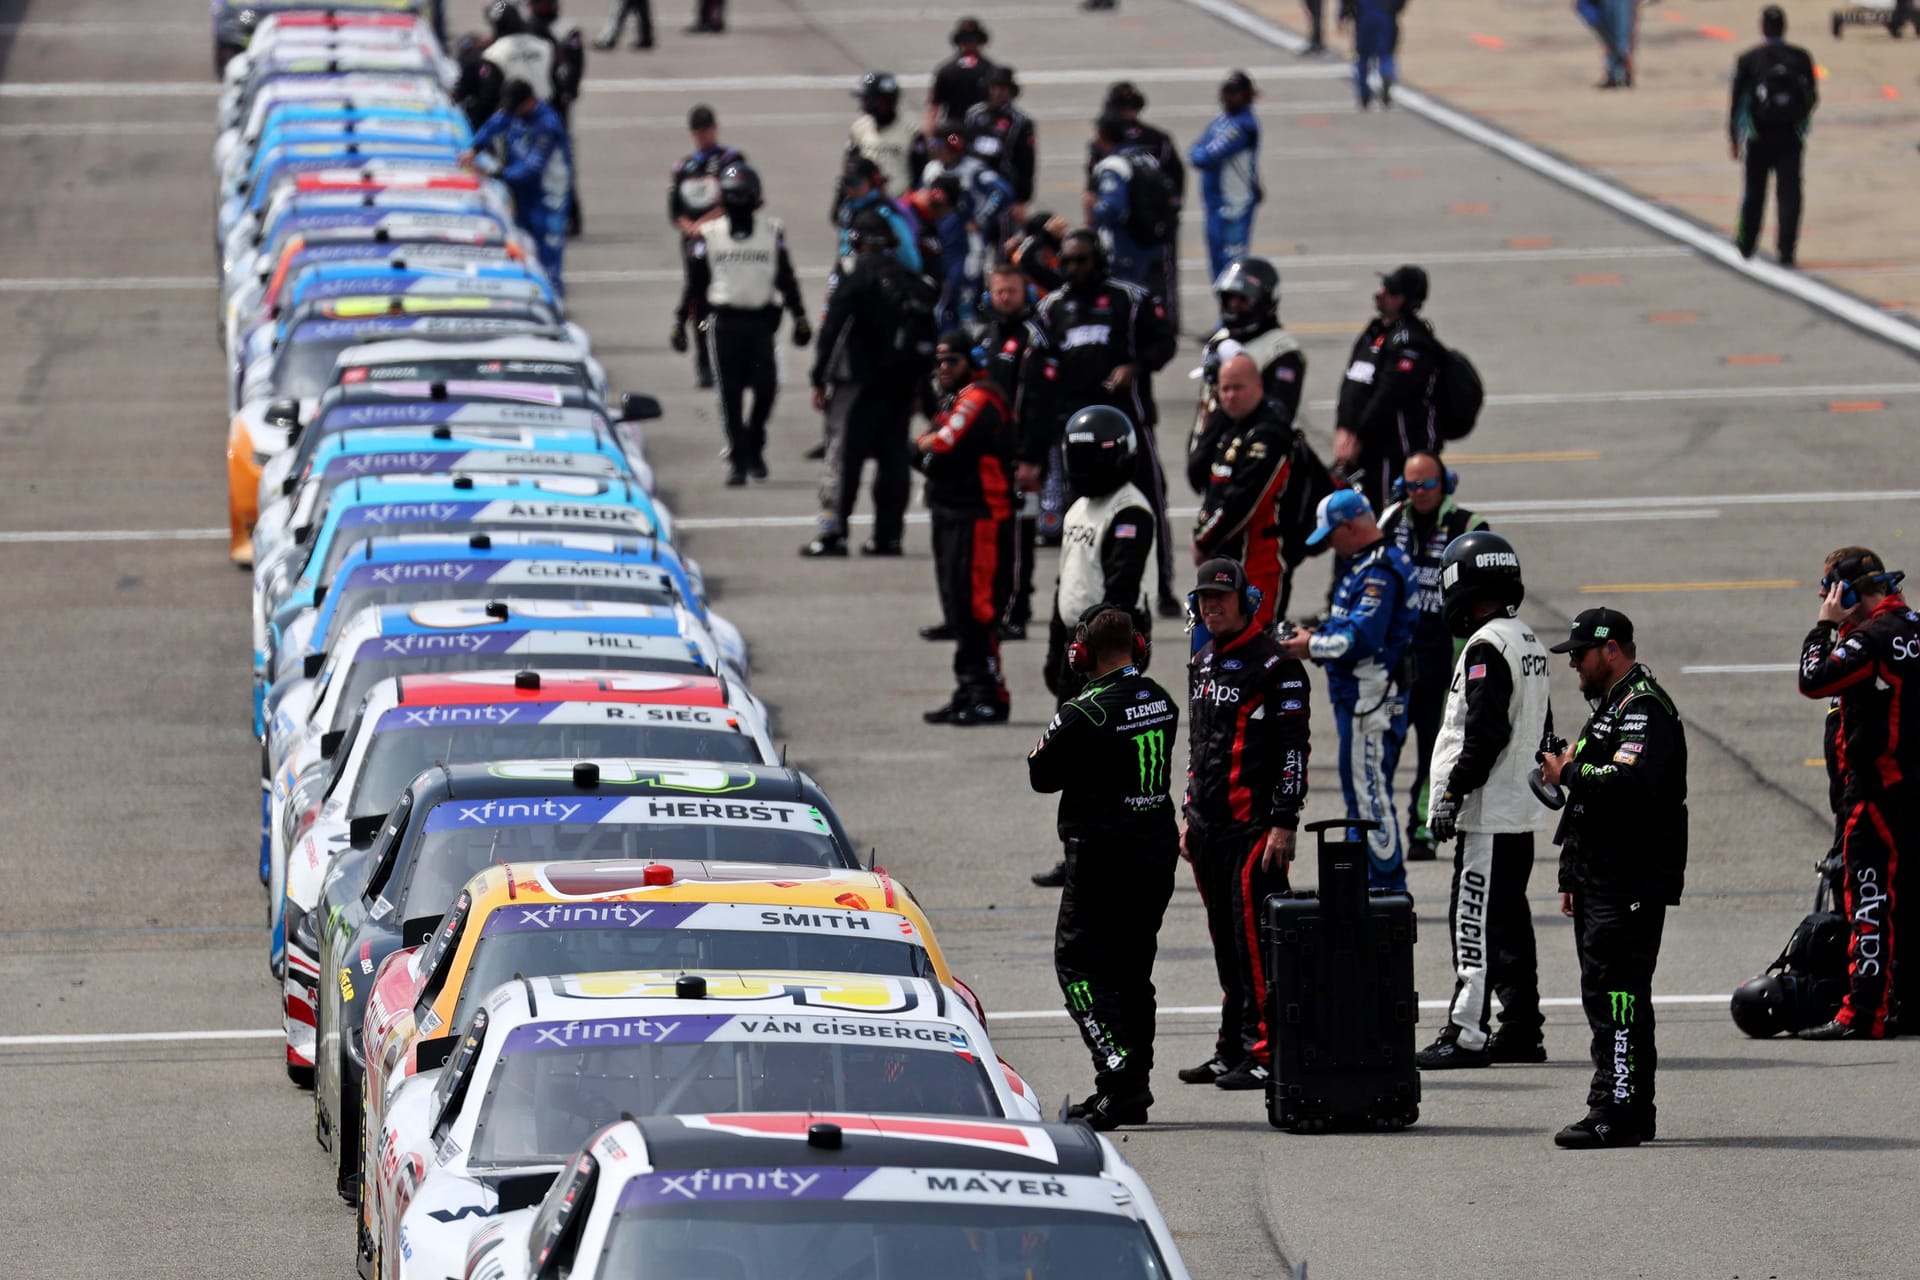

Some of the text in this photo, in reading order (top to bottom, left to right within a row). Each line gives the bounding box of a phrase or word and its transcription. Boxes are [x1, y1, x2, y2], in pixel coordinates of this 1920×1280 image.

[348, 452, 438, 471] xfinity
[505, 454, 576, 466] POOLE
[362, 501, 460, 522] xfinity
[1475, 552, 1518, 568] OFFICIAL
[371, 561, 475, 583] xfinity
[528, 564, 651, 581] CLEMENTS
[382, 631, 491, 654] xfinity
[588, 636, 642, 650] HILL
[404, 703, 520, 727] xfinity
[606, 708, 712, 724] R. SIEG
[1124, 699, 1168, 721] FLEMING
[458, 800, 582, 825] xfinity
[649, 802, 795, 823] HERBST
[520, 904, 655, 930] xfinity
[761, 911, 870, 931] SMITH
[1460, 870, 1485, 970] OFFICIAL
[1856, 867, 1887, 977] SciAps
[535, 1019, 682, 1047] xfinity
[740, 1021, 969, 1047] VAN GISBERGEN
[659, 1167, 821, 1200] xfinity
[927, 1174, 1068, 1198] MAYER
